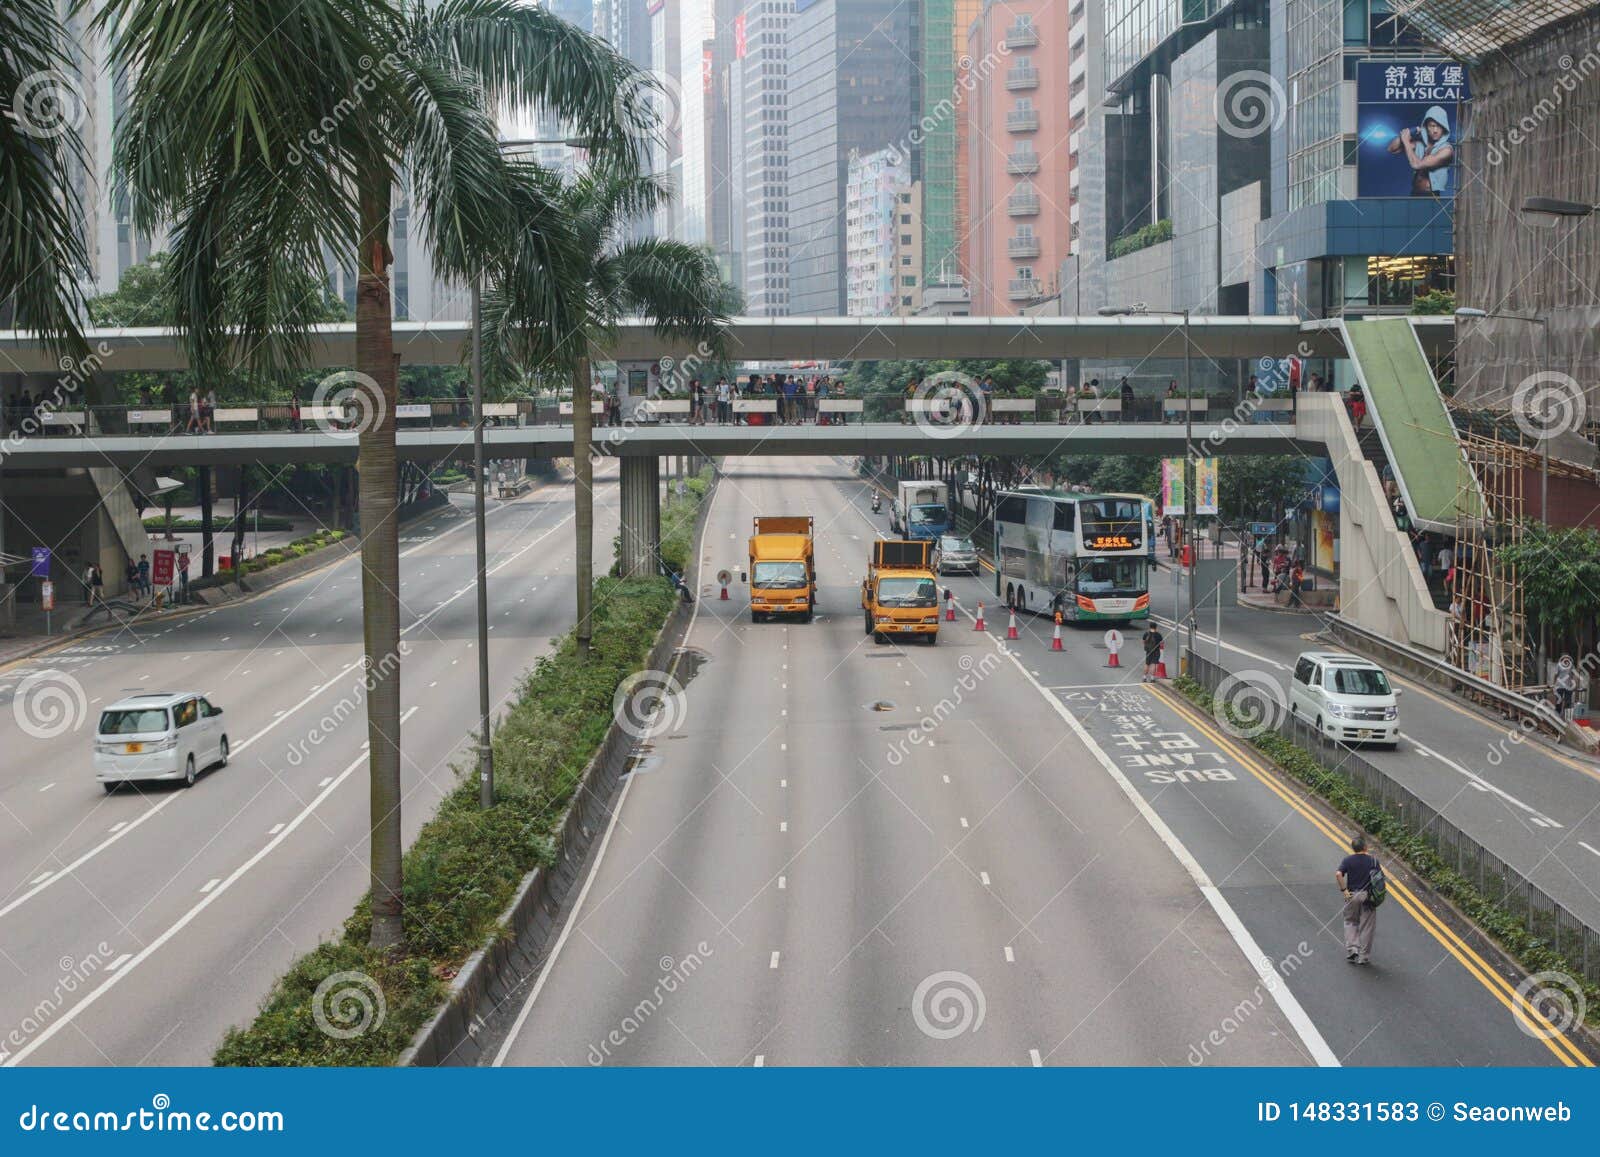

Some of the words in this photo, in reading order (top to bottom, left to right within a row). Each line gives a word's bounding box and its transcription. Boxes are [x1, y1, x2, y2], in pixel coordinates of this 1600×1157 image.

[1385, 65, 1464, 87] 舒適堡
[1385, 87, 1465, 99] PHYSICAL
[1112, 732, 1200, 750] 巴士
[1120, 752, 1228, 767] LANE
[1144, 768, 1237, 784] BUS
